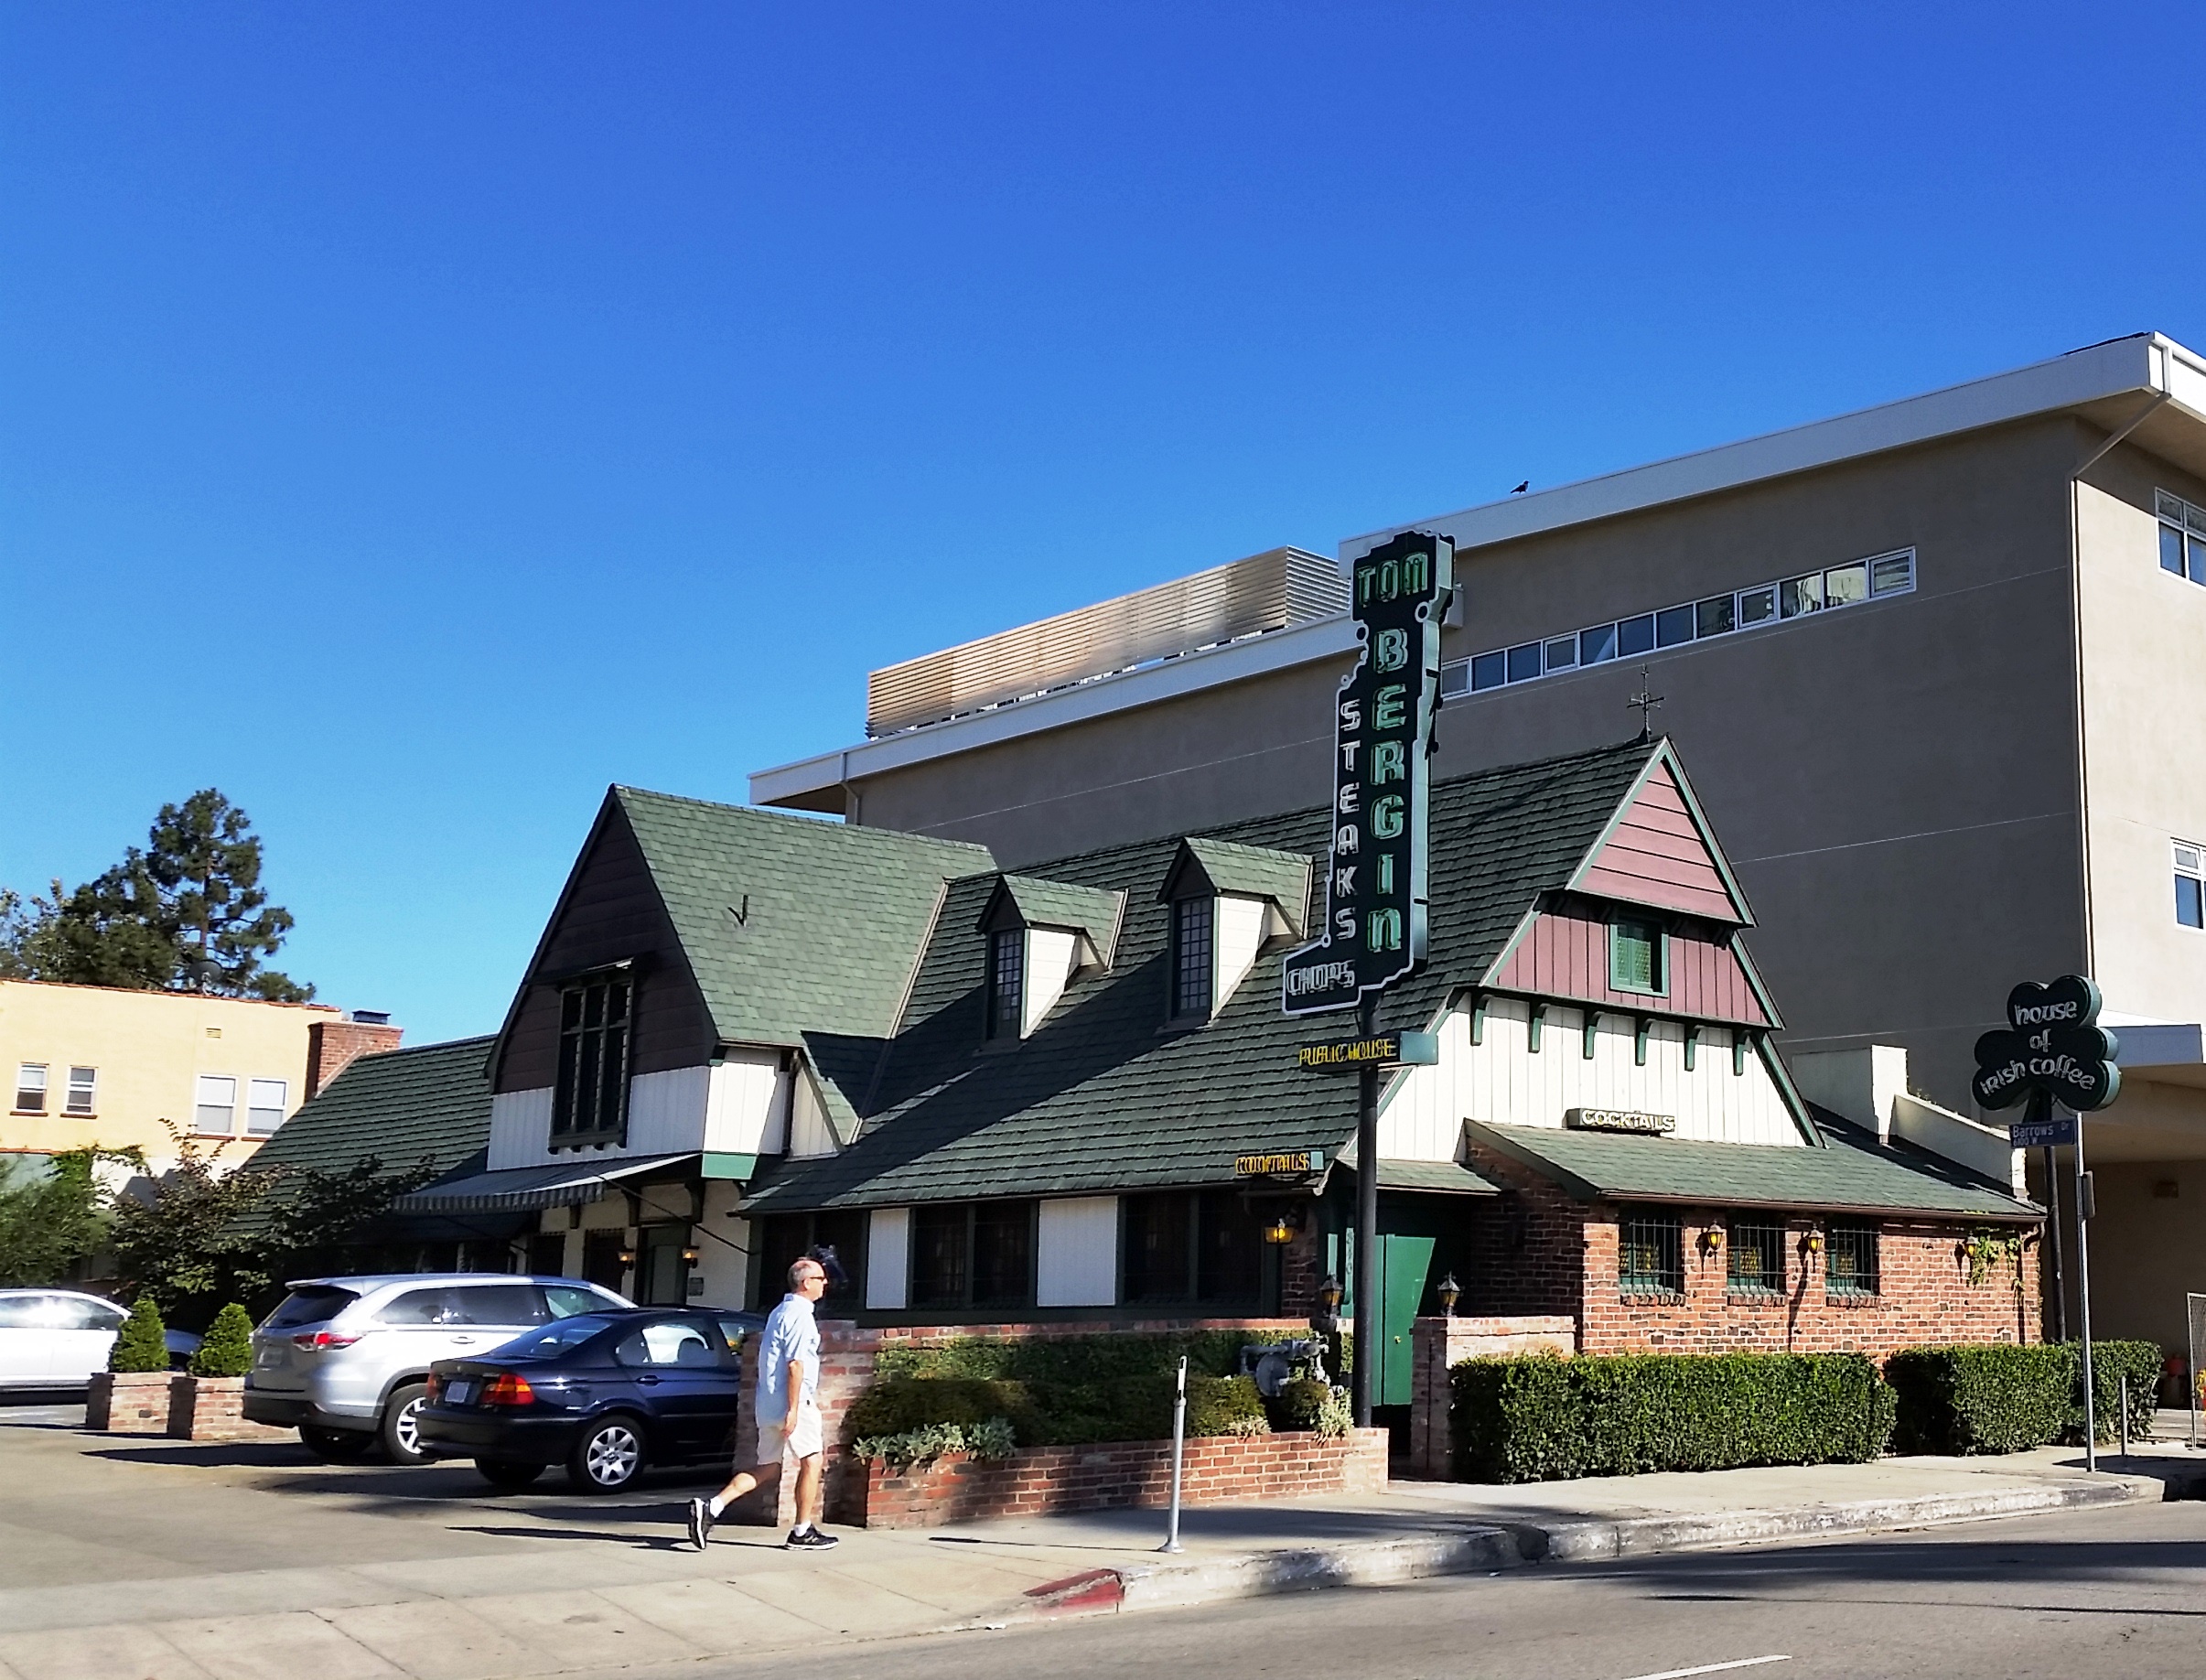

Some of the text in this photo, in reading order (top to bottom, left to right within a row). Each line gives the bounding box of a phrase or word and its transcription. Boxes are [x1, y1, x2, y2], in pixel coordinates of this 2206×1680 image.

[1356, 552, 1428, 608] TOM
[1335, 698, 1361, 941] STEAKS
[1286, 959, 1356, 996] CHOPS
[1299, 1038, 1397, 1066] PUBLIC HOUSE
[2028, 1028, 2052, 1053] of
[1581, 1109, 1676, 1132] COCKTAILS
[2013, 1125, 2054, 1138] Barrows
[1236, 1152, 1310, 1175] COCKTAILS
